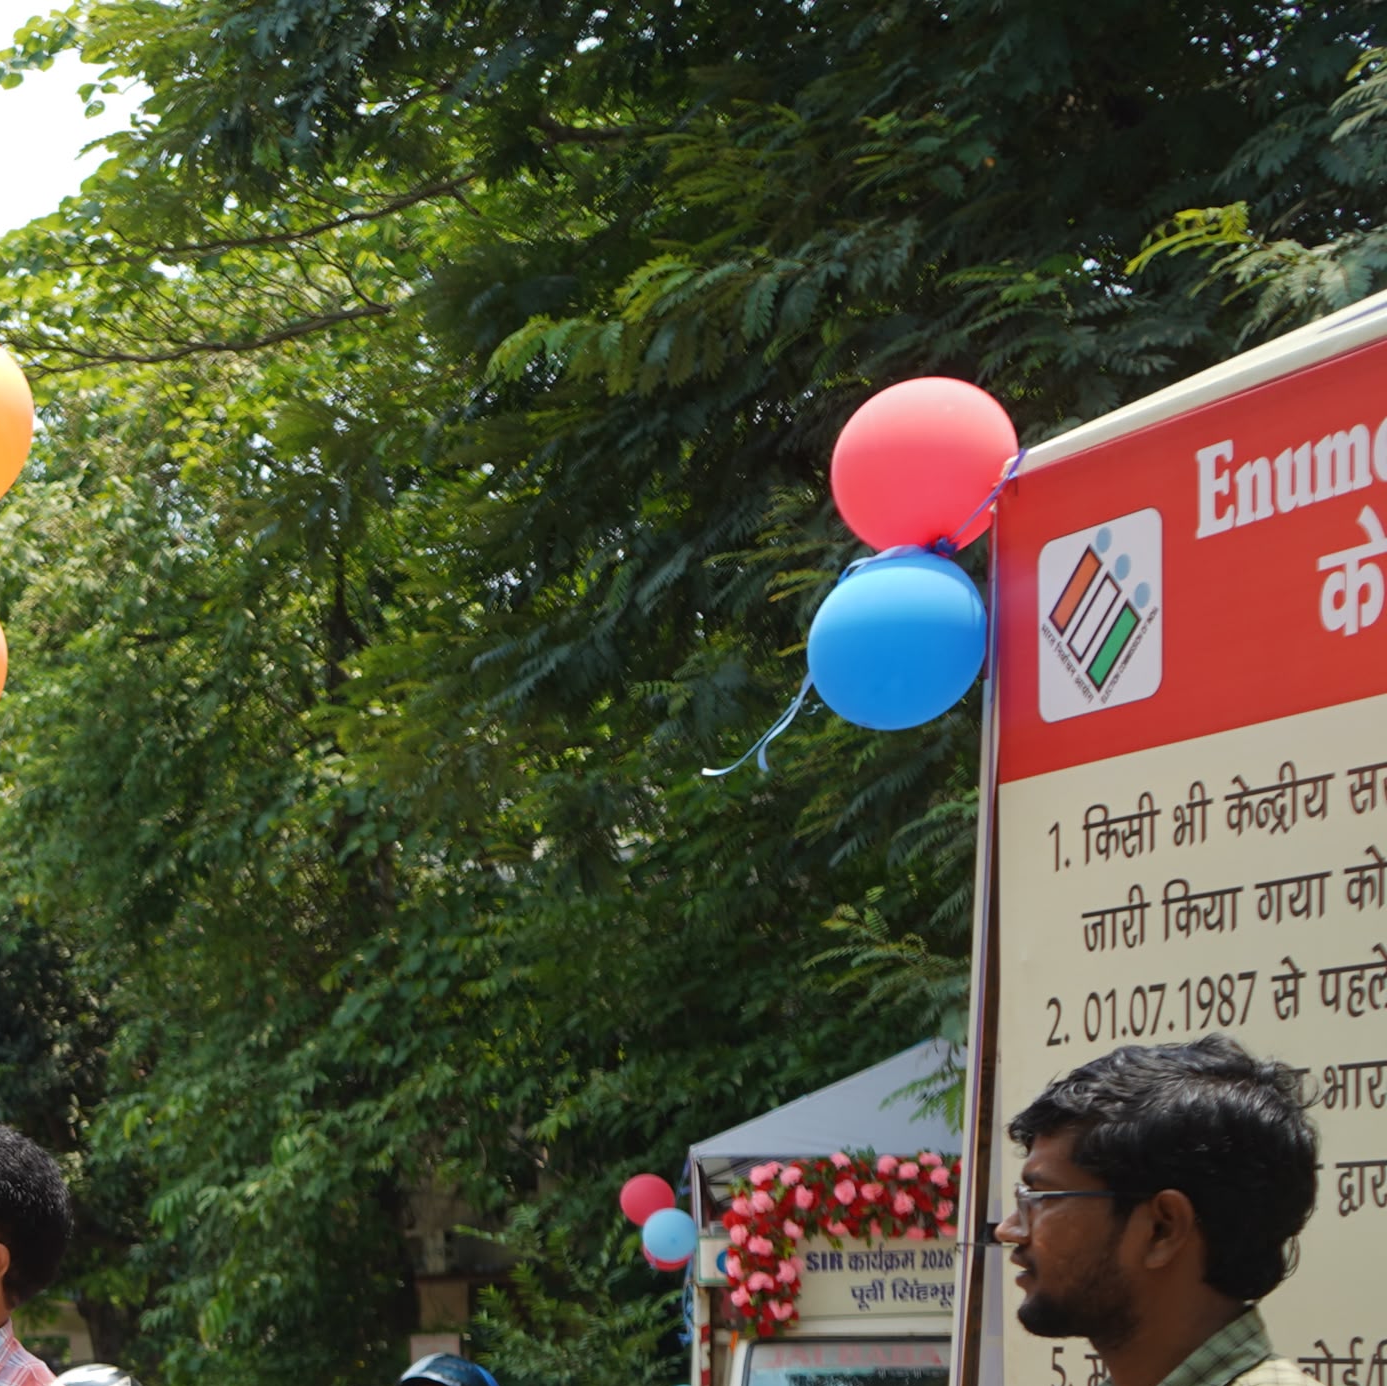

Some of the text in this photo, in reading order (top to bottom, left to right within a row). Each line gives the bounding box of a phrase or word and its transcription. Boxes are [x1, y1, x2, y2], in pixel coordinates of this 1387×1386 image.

[1048, 821, 1071, 872] 1.
[1082, 791, 1162, 866] किसी
[1173, 780, 1214, 847] भी
[1224, 760, 1335, 836] केन्द्रीय
[1082, 884, 1152, 952] जारी
[1162, 879, 1244, 942] किया
[1254, 871, 1333, 925] गया
[1046, 997, 1071, 1047] 2.
[1083, 971, 1258, 1042] 01.07.1987
[1271, 956, 1307, 1021] से
[806, 1250, 844, 1273] SIR
[848, 1243, 916, 1274] कार्यक्रम
[892, 1277, 955, 1308] सिंहभू
[765, 1345, 942, 1369] JAI BABA
